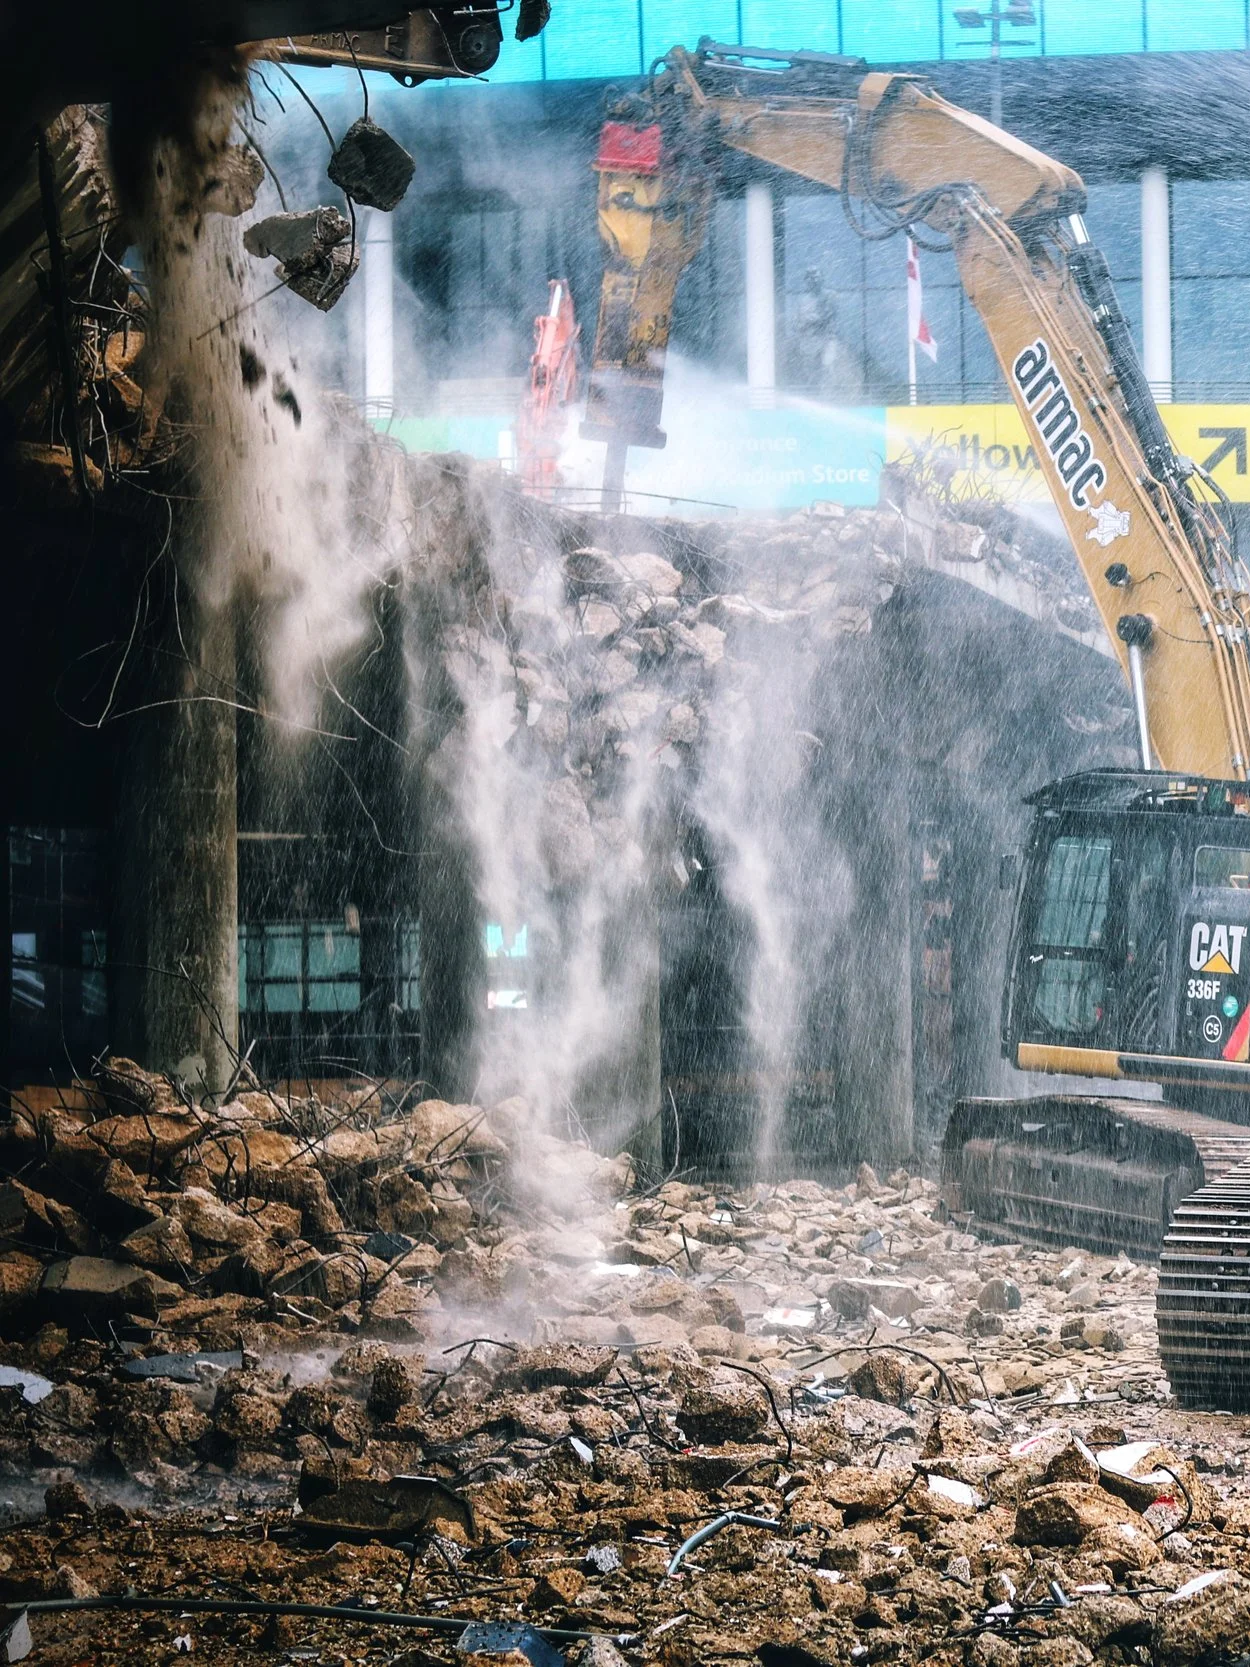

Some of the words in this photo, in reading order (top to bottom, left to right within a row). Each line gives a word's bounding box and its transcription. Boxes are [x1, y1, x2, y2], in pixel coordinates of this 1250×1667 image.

[1013, 340, 1106, 509] armac
[811, 464, 870, 484] Store
[1190, 922, 1246, 974] CAT
[1187, 979, 1221, 1000] 336F
[1206, 1022, 1220, 1036] C5
